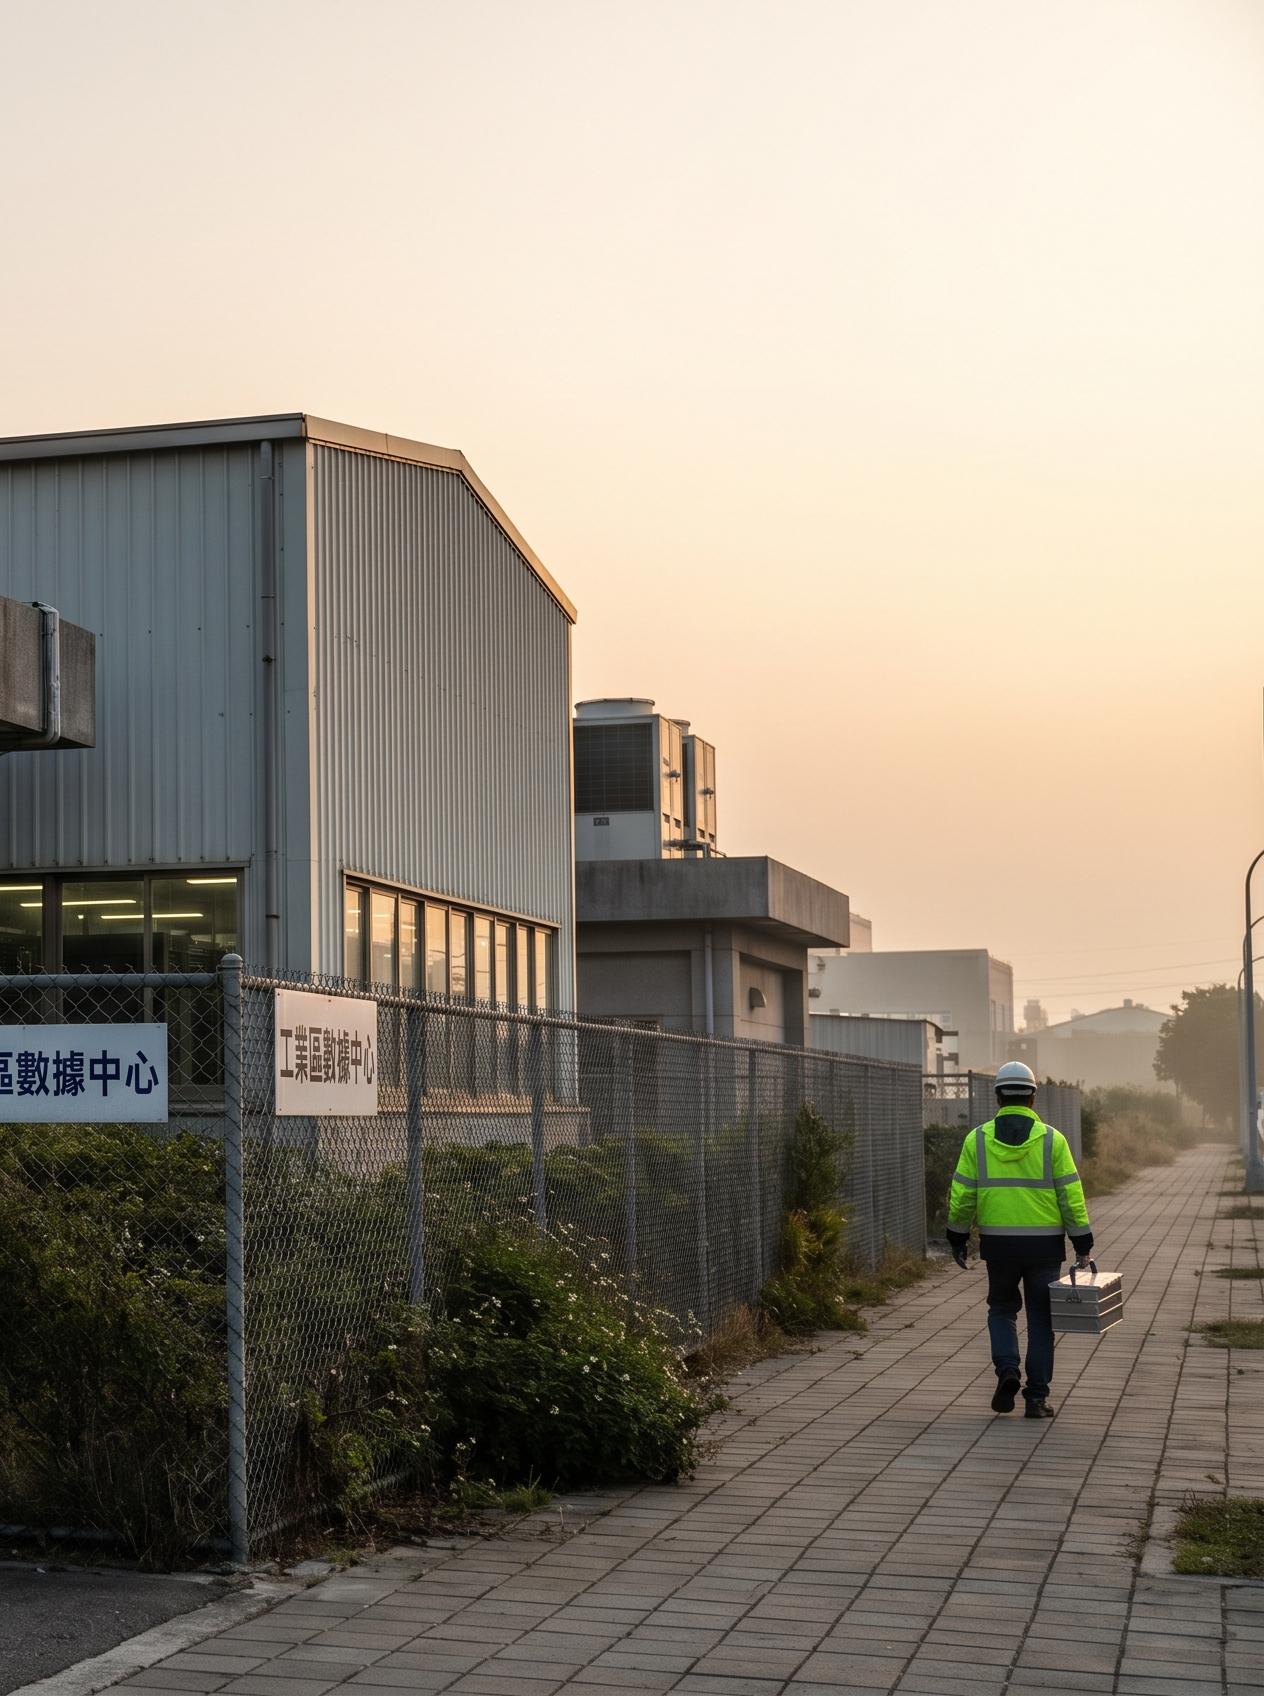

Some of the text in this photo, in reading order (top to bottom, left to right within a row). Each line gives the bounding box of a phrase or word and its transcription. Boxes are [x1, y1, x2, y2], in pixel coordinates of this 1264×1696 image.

[280, 1024, 375, 1085] 工業區數據中心
